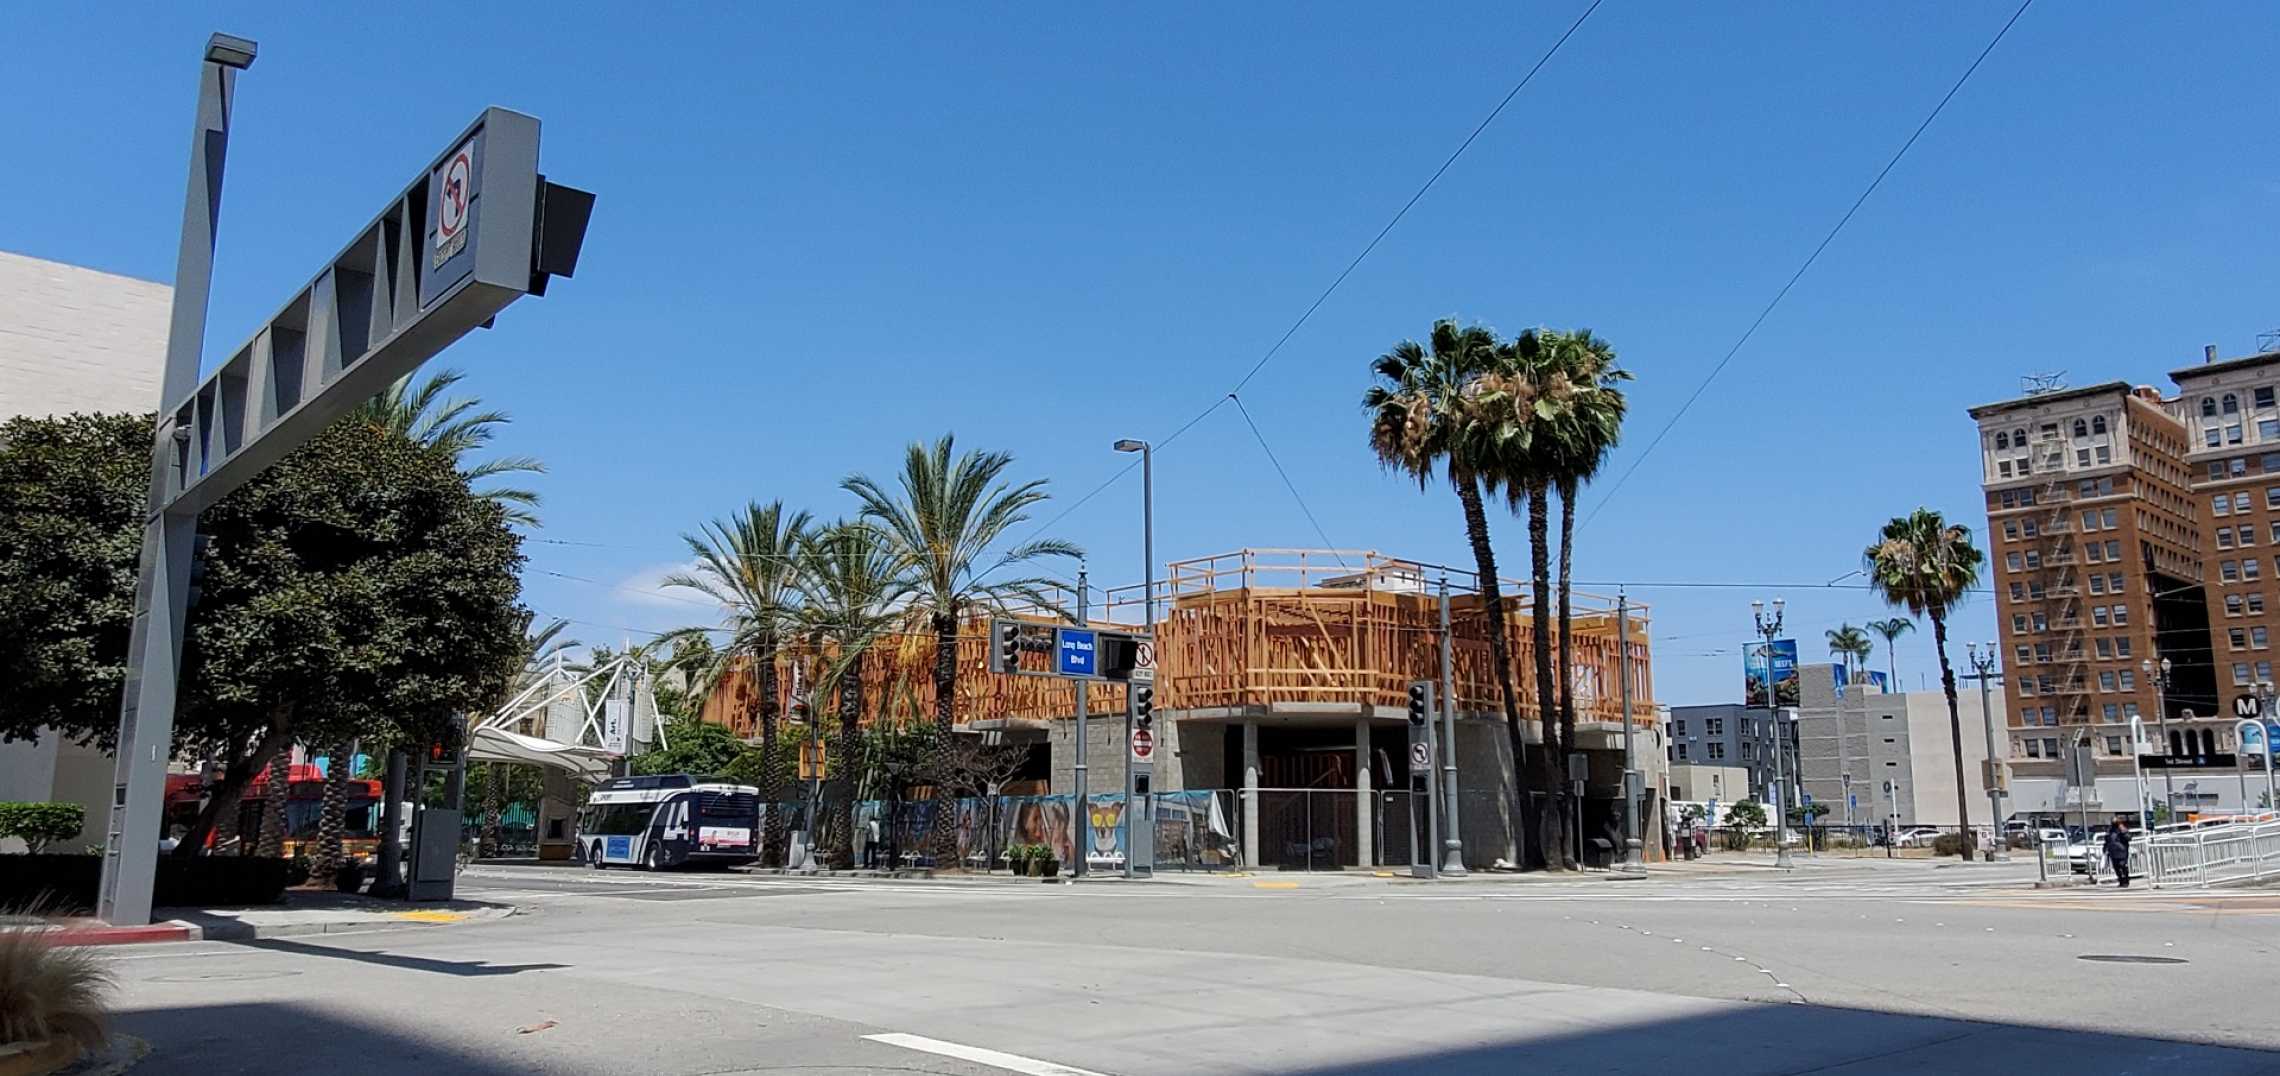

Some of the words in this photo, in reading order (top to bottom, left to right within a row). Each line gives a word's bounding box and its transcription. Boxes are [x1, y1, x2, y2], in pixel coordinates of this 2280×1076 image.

[1062, 640, 1076, 650] Long
[1077, 640, 1093, 650] Beach
[1070, 655, 1085, 664] Blvd
[2237, 698, 2257, 714] M
